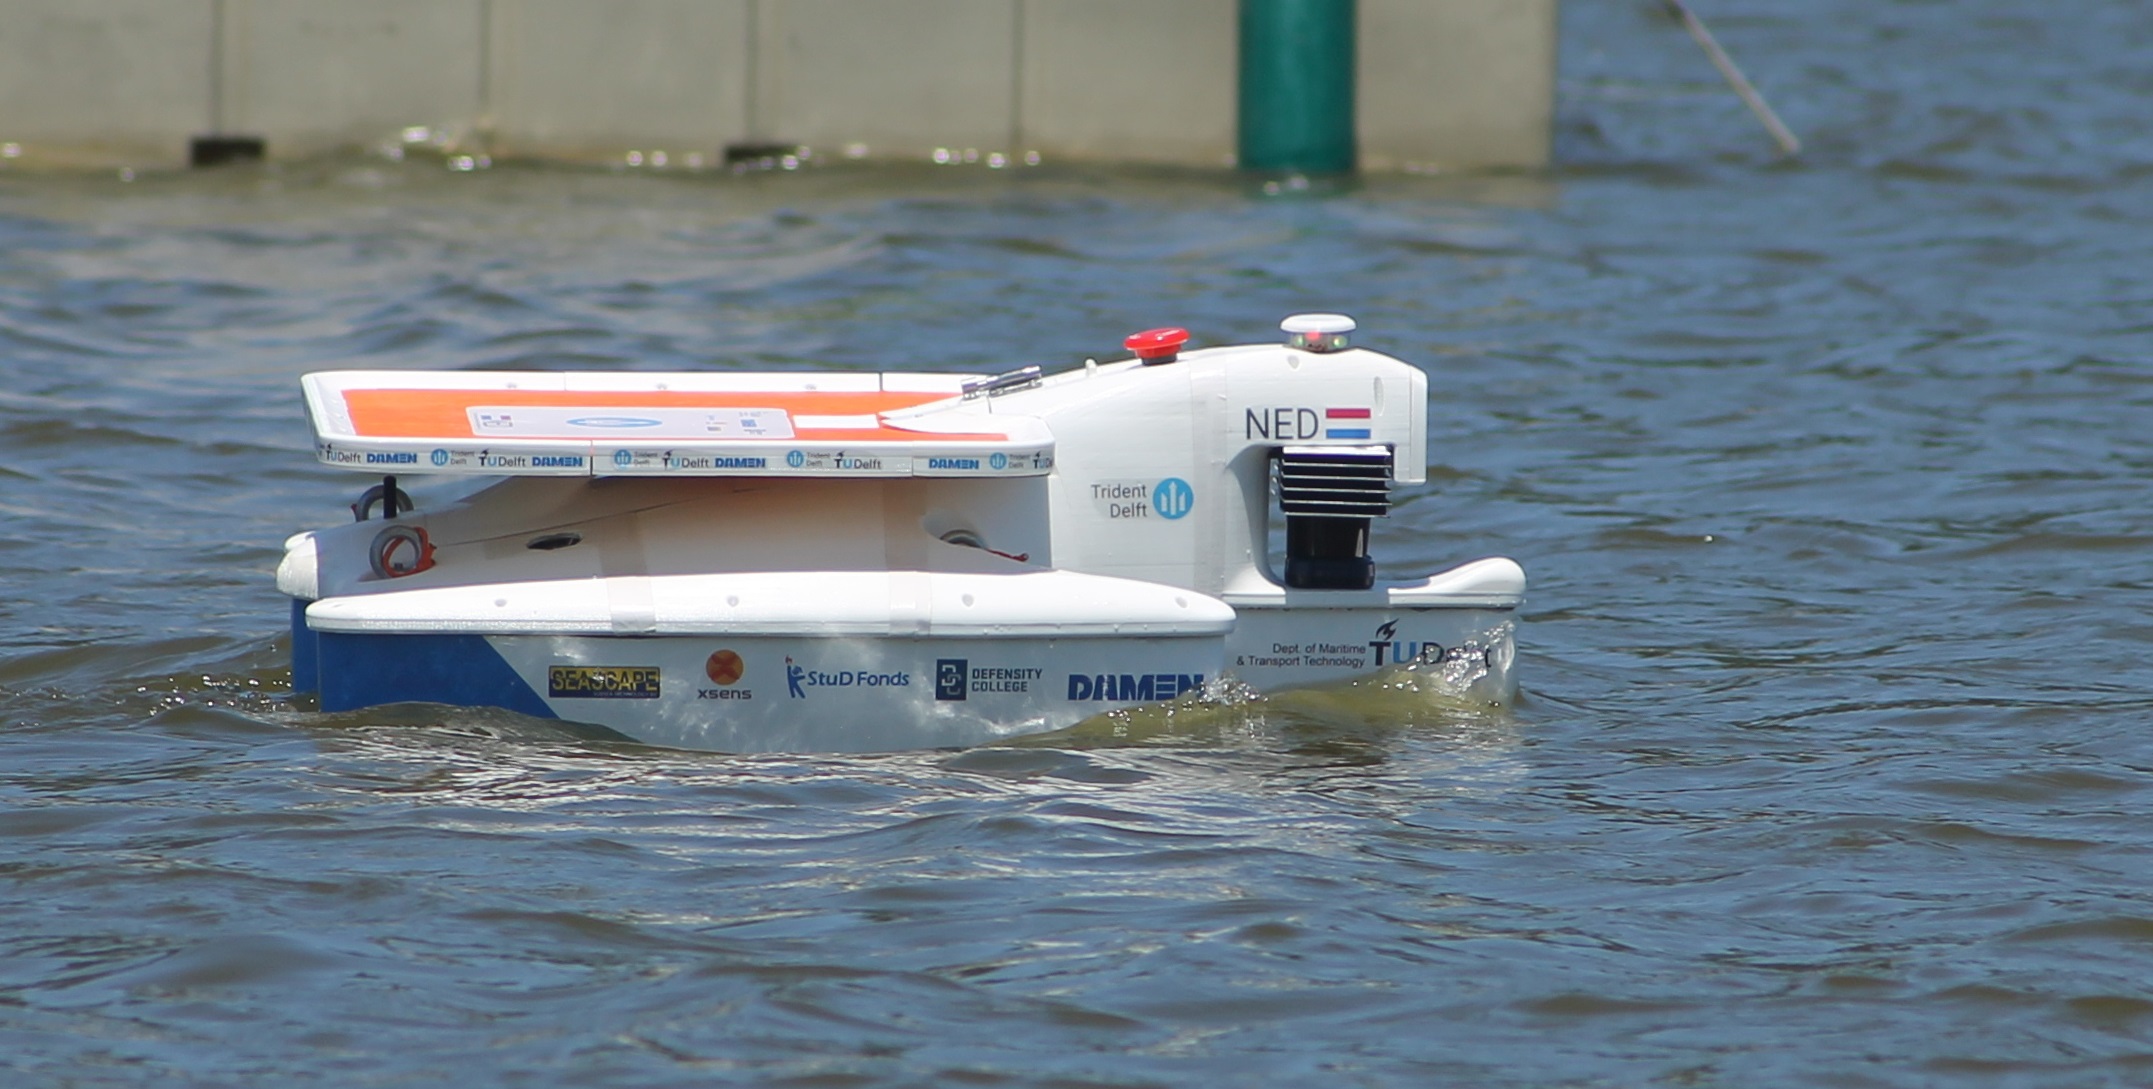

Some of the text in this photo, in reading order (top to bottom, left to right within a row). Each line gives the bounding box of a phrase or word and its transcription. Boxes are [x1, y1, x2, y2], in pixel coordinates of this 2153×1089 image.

[1246, 408, 1319, 440] NED
[366, 453, 417, 464] DAMEN
[532, 456, 583, 467] DAMEN
[715, 457, 766, 468] DAMEN
[928, 458, 979, 469] DAMEN
[1091, 484, 1147, 499] Trident
[1110, 502, 1148, 518] Delft
[1305, 643, 1317, 654] of
[1319, 643, 1367, 654] Maritime
[1236, 656, 1365, 669] & Transport Technology
[552, 669, 659, 691] SEASCAPE
[807, 671, 910, 687] StuD Fonds
[972, 668, 1043, 680] DEFENSITY
[972, 681, 1028, 692] COLLEGE
[1068, 674, 1204, 701] DAMEN
[697, 688, 752, 700] xsens
